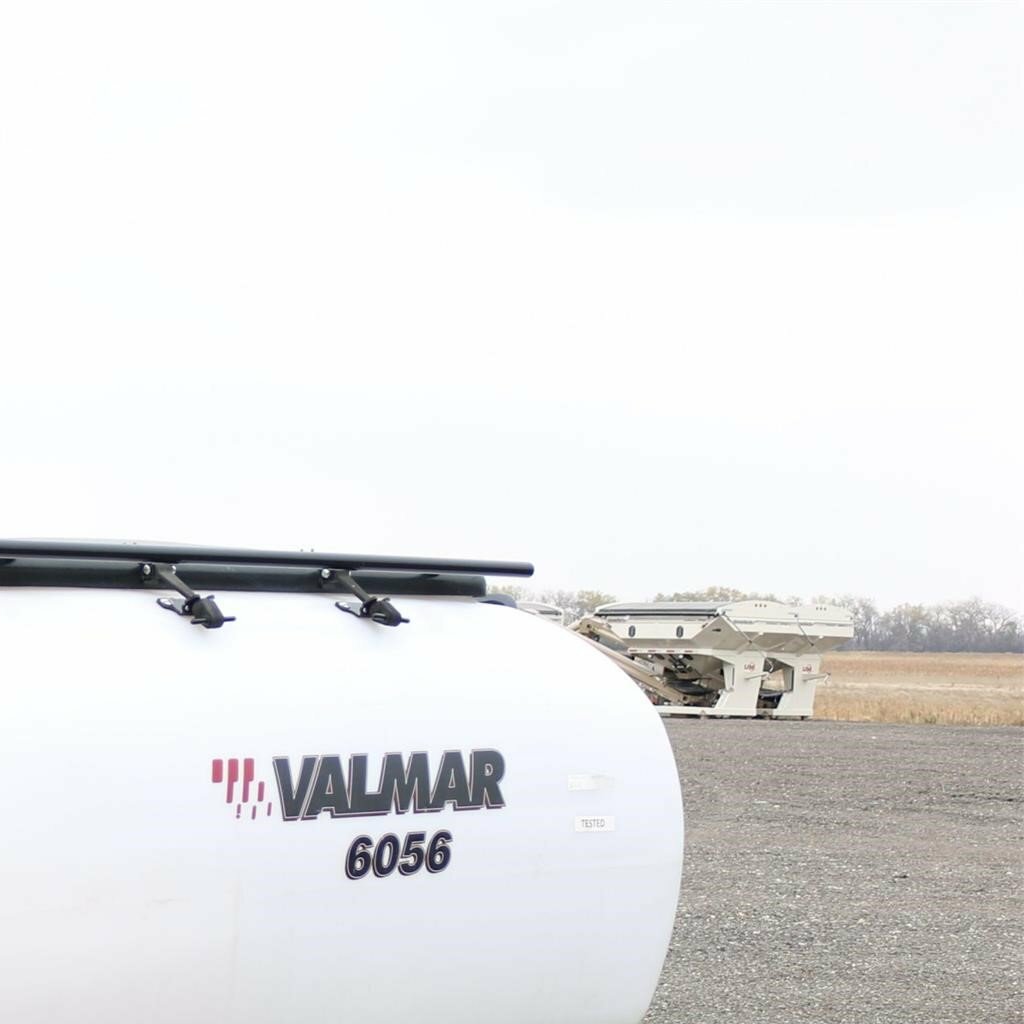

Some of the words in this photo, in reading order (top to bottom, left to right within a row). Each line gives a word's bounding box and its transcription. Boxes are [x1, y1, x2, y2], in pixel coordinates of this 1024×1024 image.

[272, 748, 507, 822] VALMAR
[581, 818, 606, 828] TESTED
[344, 829, 454, 880] 6056
